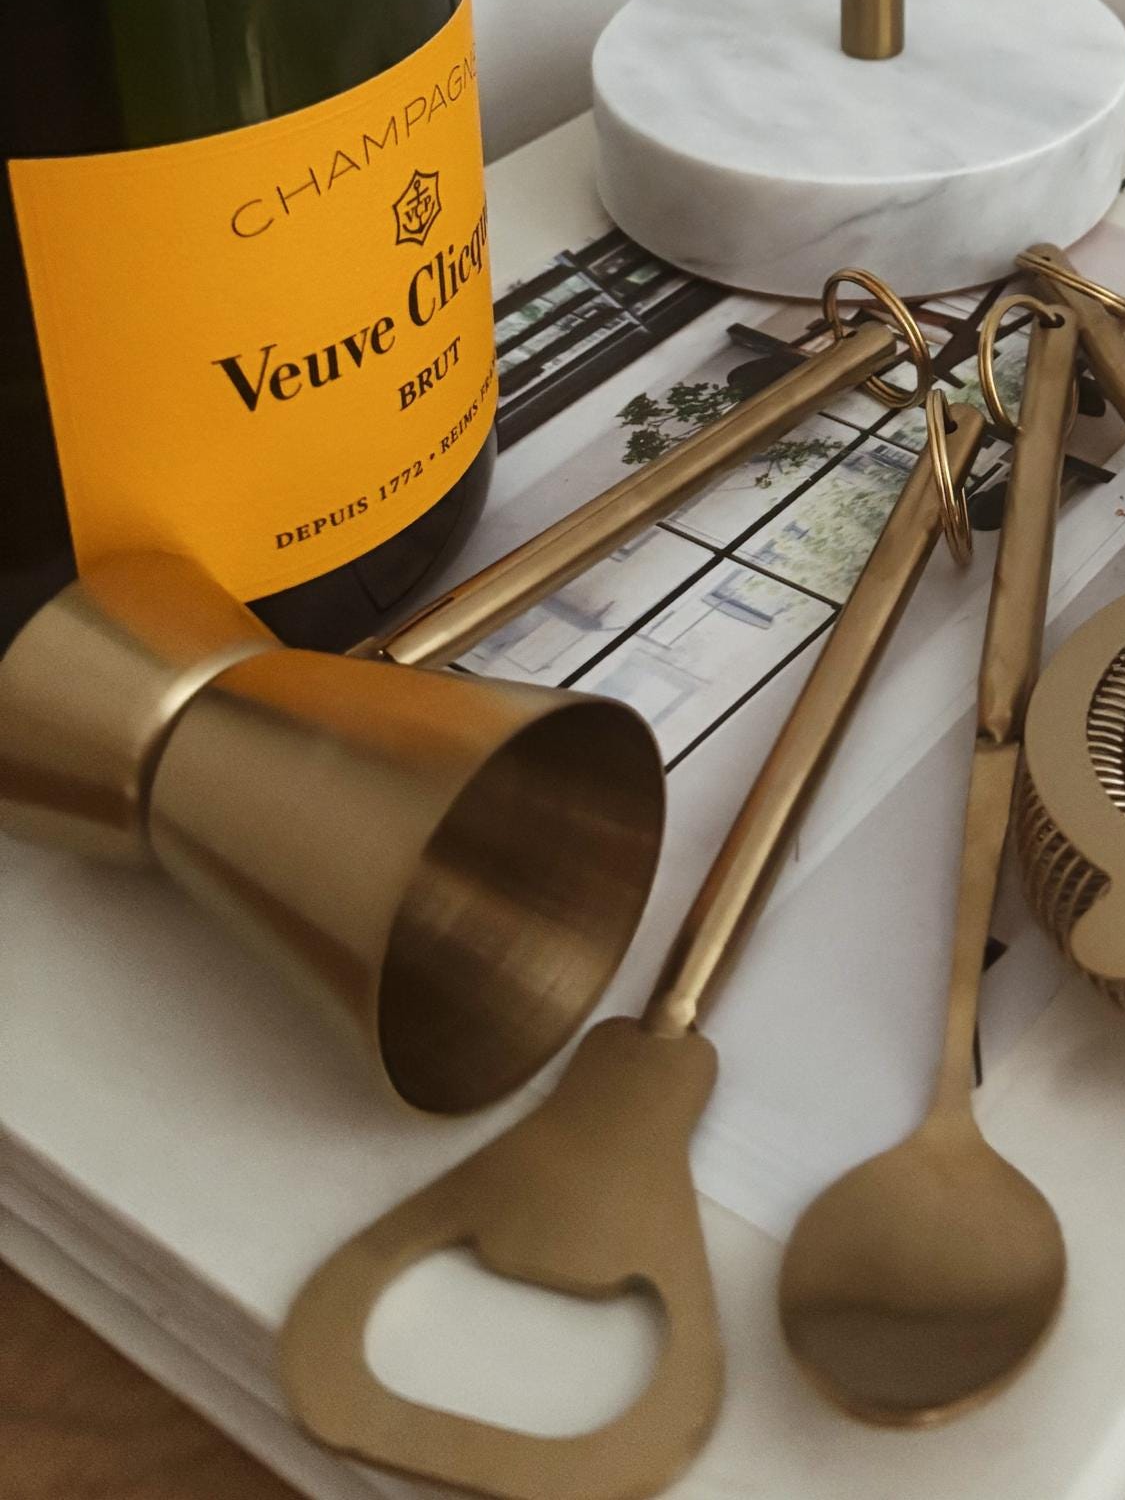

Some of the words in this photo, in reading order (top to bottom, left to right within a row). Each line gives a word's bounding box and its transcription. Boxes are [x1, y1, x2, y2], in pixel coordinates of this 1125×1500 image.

[211, 315, 397, 413] Veuve
[397, 336, 461, 412] BRUT
[275, 496, 370, 550] DEPUIS
[379, 460, 424, 501] 1772
[440, 400, 479, 454] REIMS
